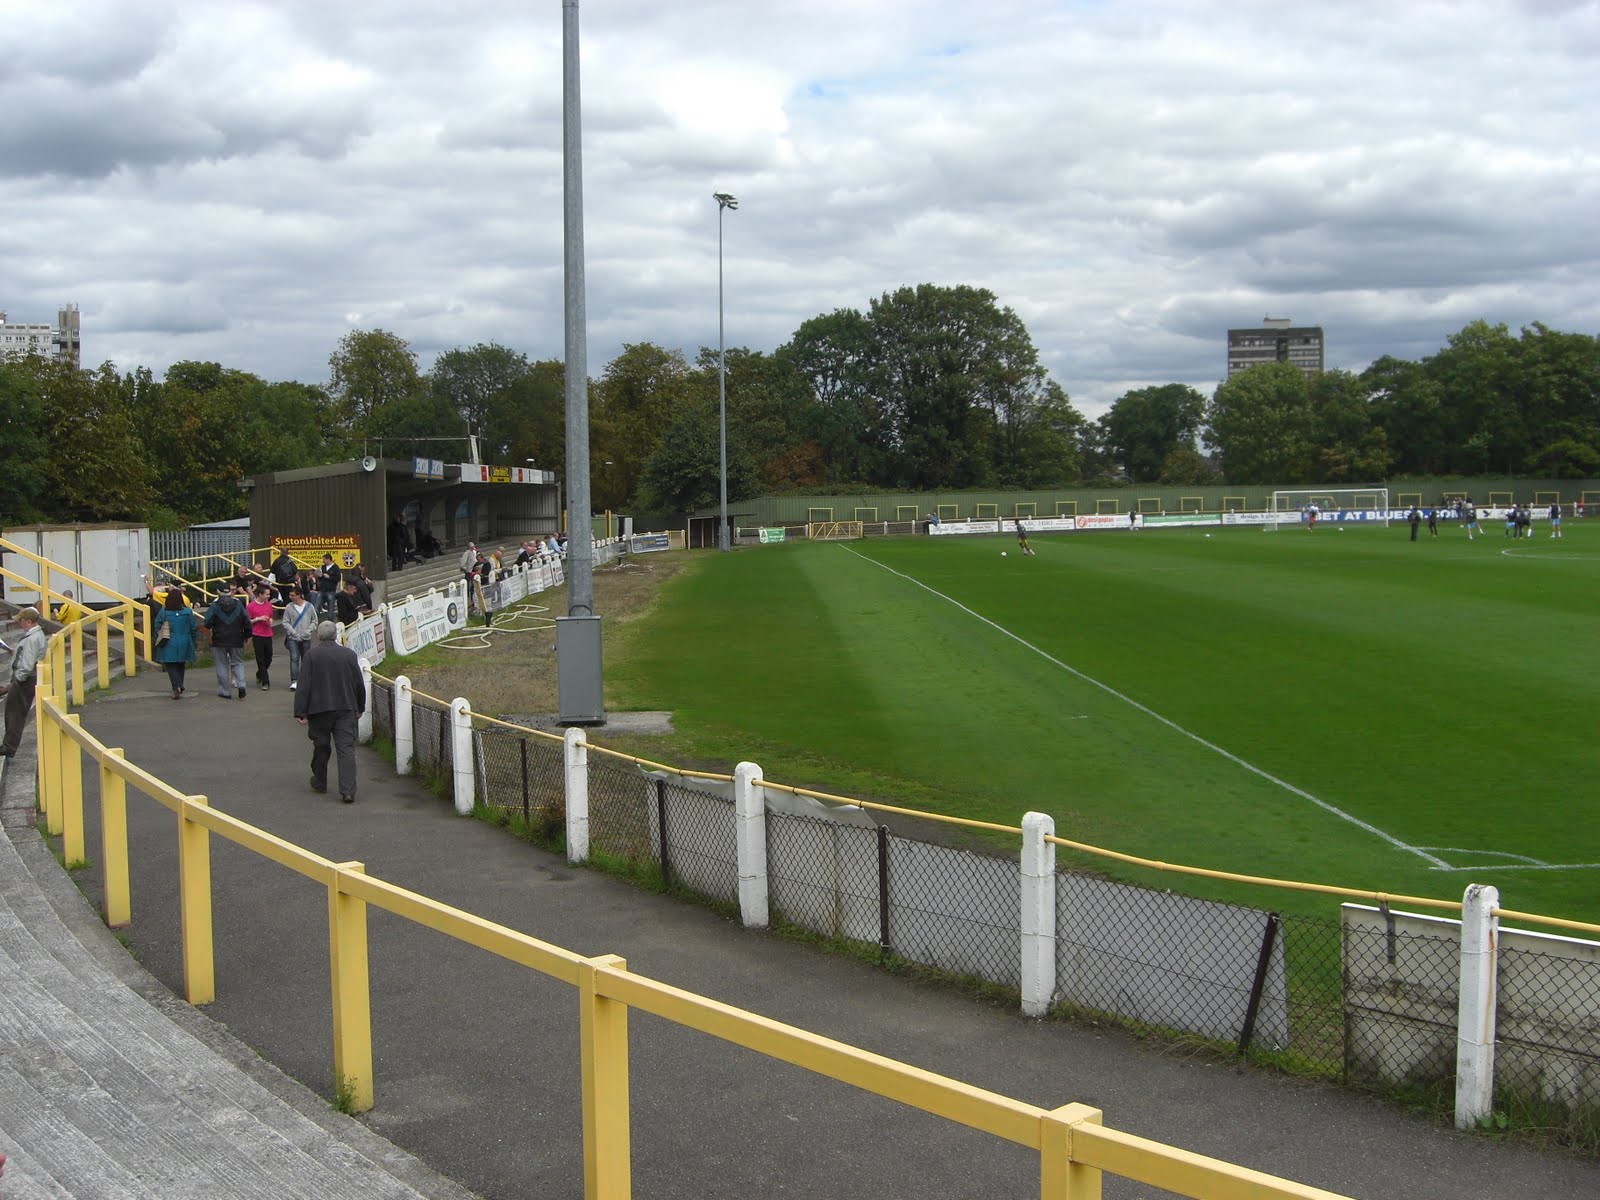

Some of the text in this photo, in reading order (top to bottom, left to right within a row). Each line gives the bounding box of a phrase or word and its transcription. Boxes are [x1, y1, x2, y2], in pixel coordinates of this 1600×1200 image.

[1315, 511, 1340, 520] BET
[1344, 511, 1362, 520] AT
[275, 536, 354, 545] SuttonUnited.net
